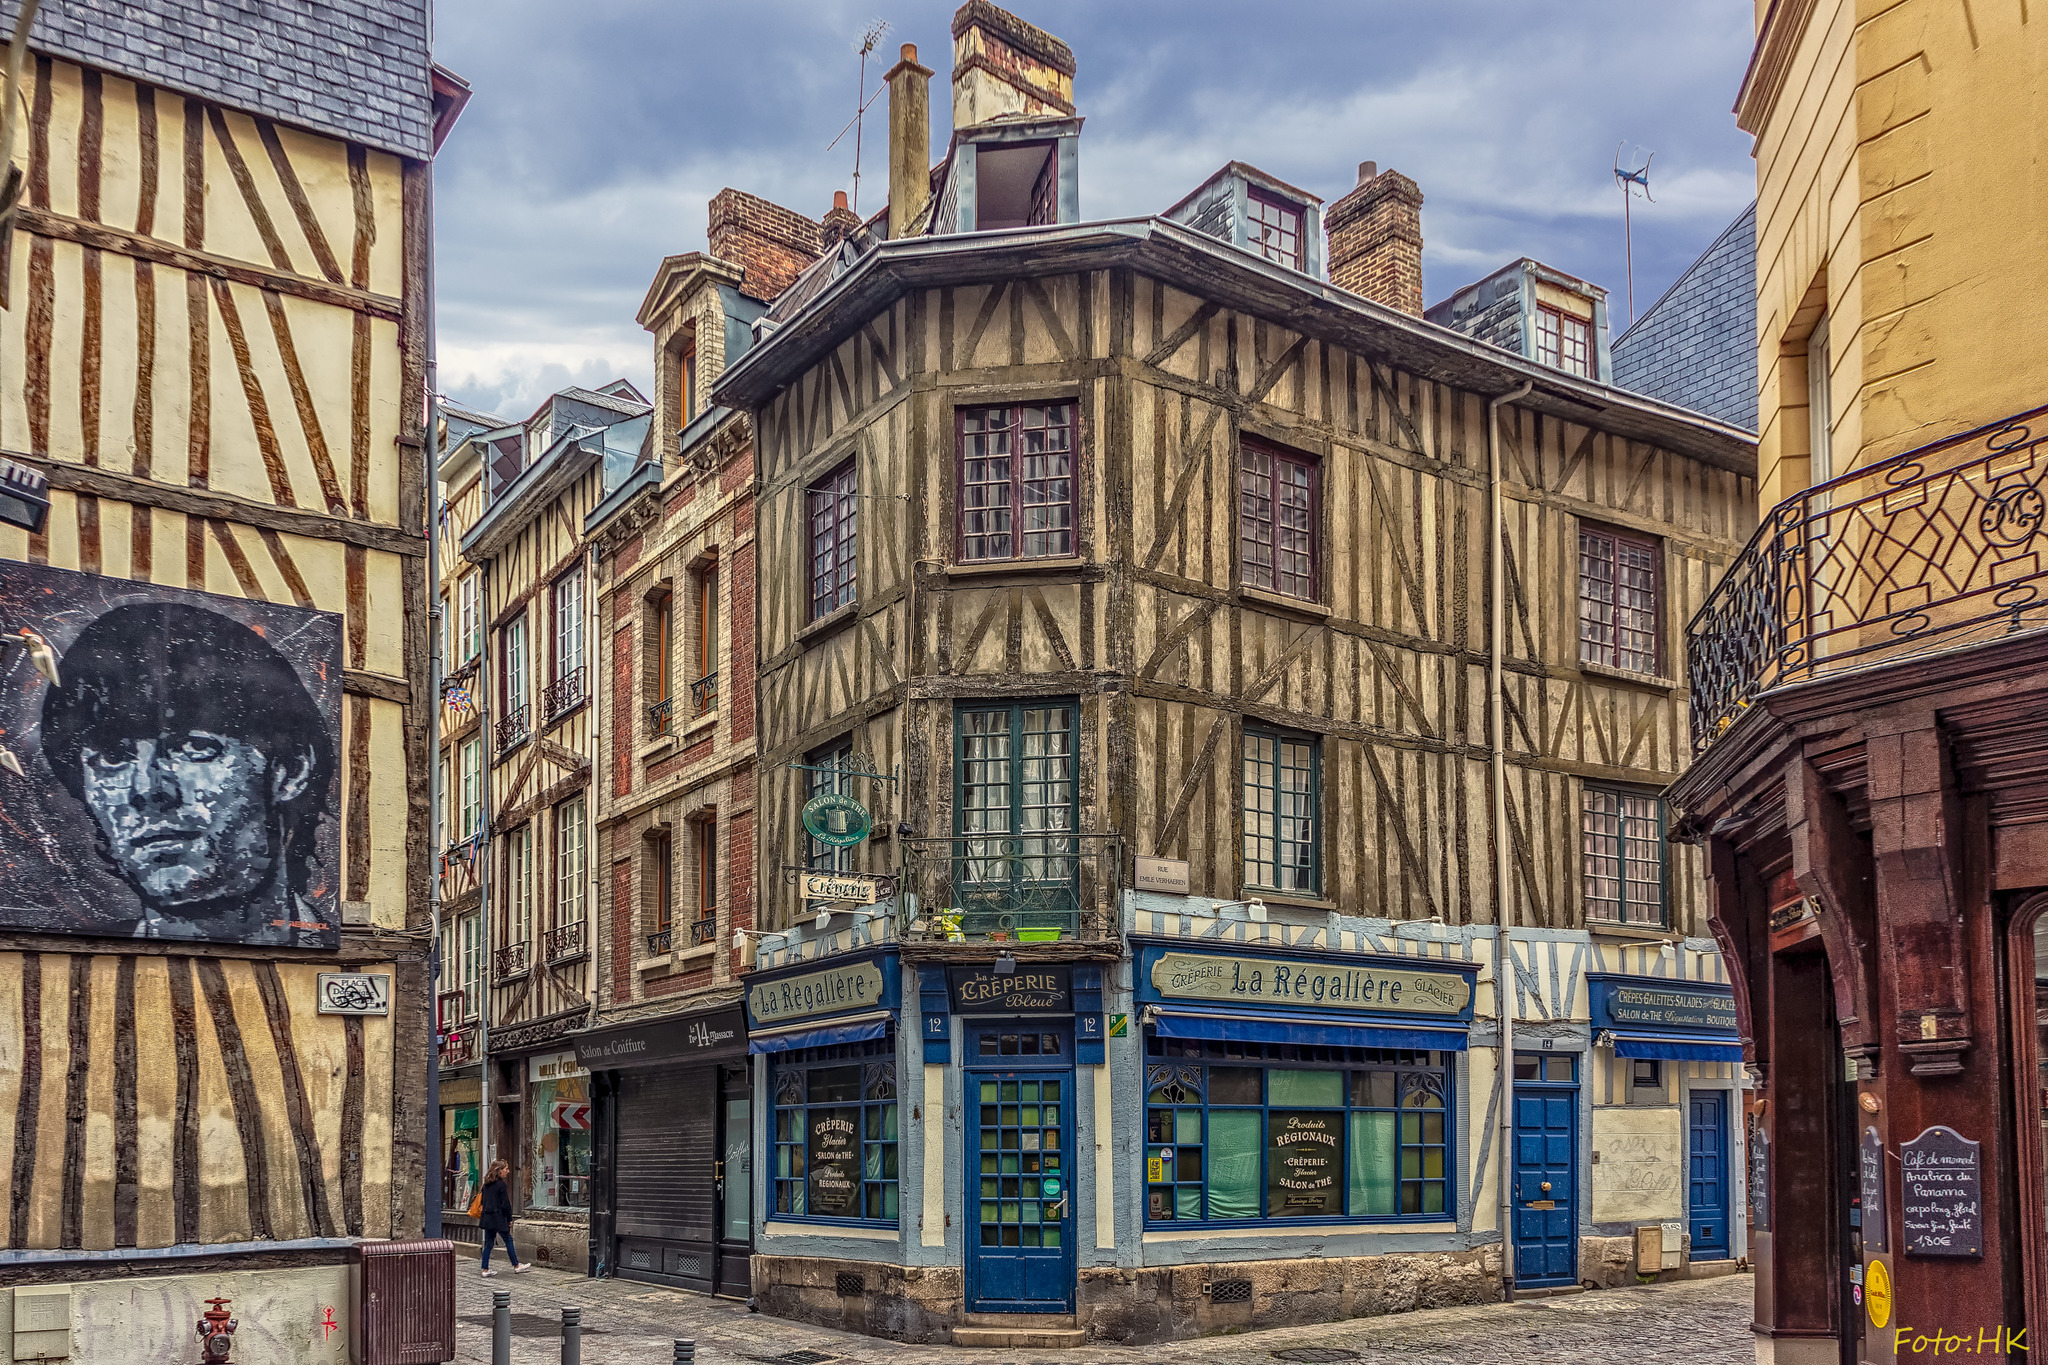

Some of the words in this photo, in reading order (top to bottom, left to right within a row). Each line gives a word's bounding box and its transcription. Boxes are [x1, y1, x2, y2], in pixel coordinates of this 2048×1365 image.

[807, 796, 836, 813] SALON
[839, 797, 847, 805] de
[1156, 877, 1186, 886] VERHAEREN
[1810, 895, 1821, 914] 8
[975, 973, 988, 982] La
[1172, 966, 1223, 989] CRÊPERIE
[1231, 962, 1263, 995] La
[1273, 966, 1403, 1004] Régalière
[1414, 978, 1454, 1007] GLACIER
[759, 987, 778, 1014] La
[781, 973, 866, 1012] Régalière
[960, 974, 1057, 1000] CRÊPERIE
[1005, 993, 1054, 1008] Bleue
[928, 1018, 941, 1032] 12
[1083, 1017, 1096, 1032] 12
[1618, 1008, 1641, 1020] SALON
[1641, 1011, 1649, 1020] de
[1707, 1014, 1737, 1027] BOUTIQUE
[694, 1021, 710, 1047] 14
[581, 1045, 602, 1059] Salon
[604, 1046, 611, 1056] de
[611, 1040, 646, 1055] Coiffure
[815, 1117, 854, 1135] CRÊPERIE
[1287, 1116, 1326, 1129] Produits
[822, 1133, 847, 1148] Glacier
[1276, 1131, 1336, 1147] RÉGIONAUX
[817, 1152, 835, 1160] SALON
[1286, 1156, 1325, 1166] CRÊPERIE
[1903, 1150, 1925, 1169] Café
[1940, 1152, 1976, 1164] moment
[824, 1168, 845, 1178] Produits
[1294, 1168, 1317, 1178] Glacier
[1906, 1170, 1953, 1182] Arabica
[1957, 1172, 1973, 1180] du
[1279, 1177, 1308, 1189] SALON
[1914, 1183, 1968, 1197] Panama
[1914, 1235, 1951, 1247] 1,80€
